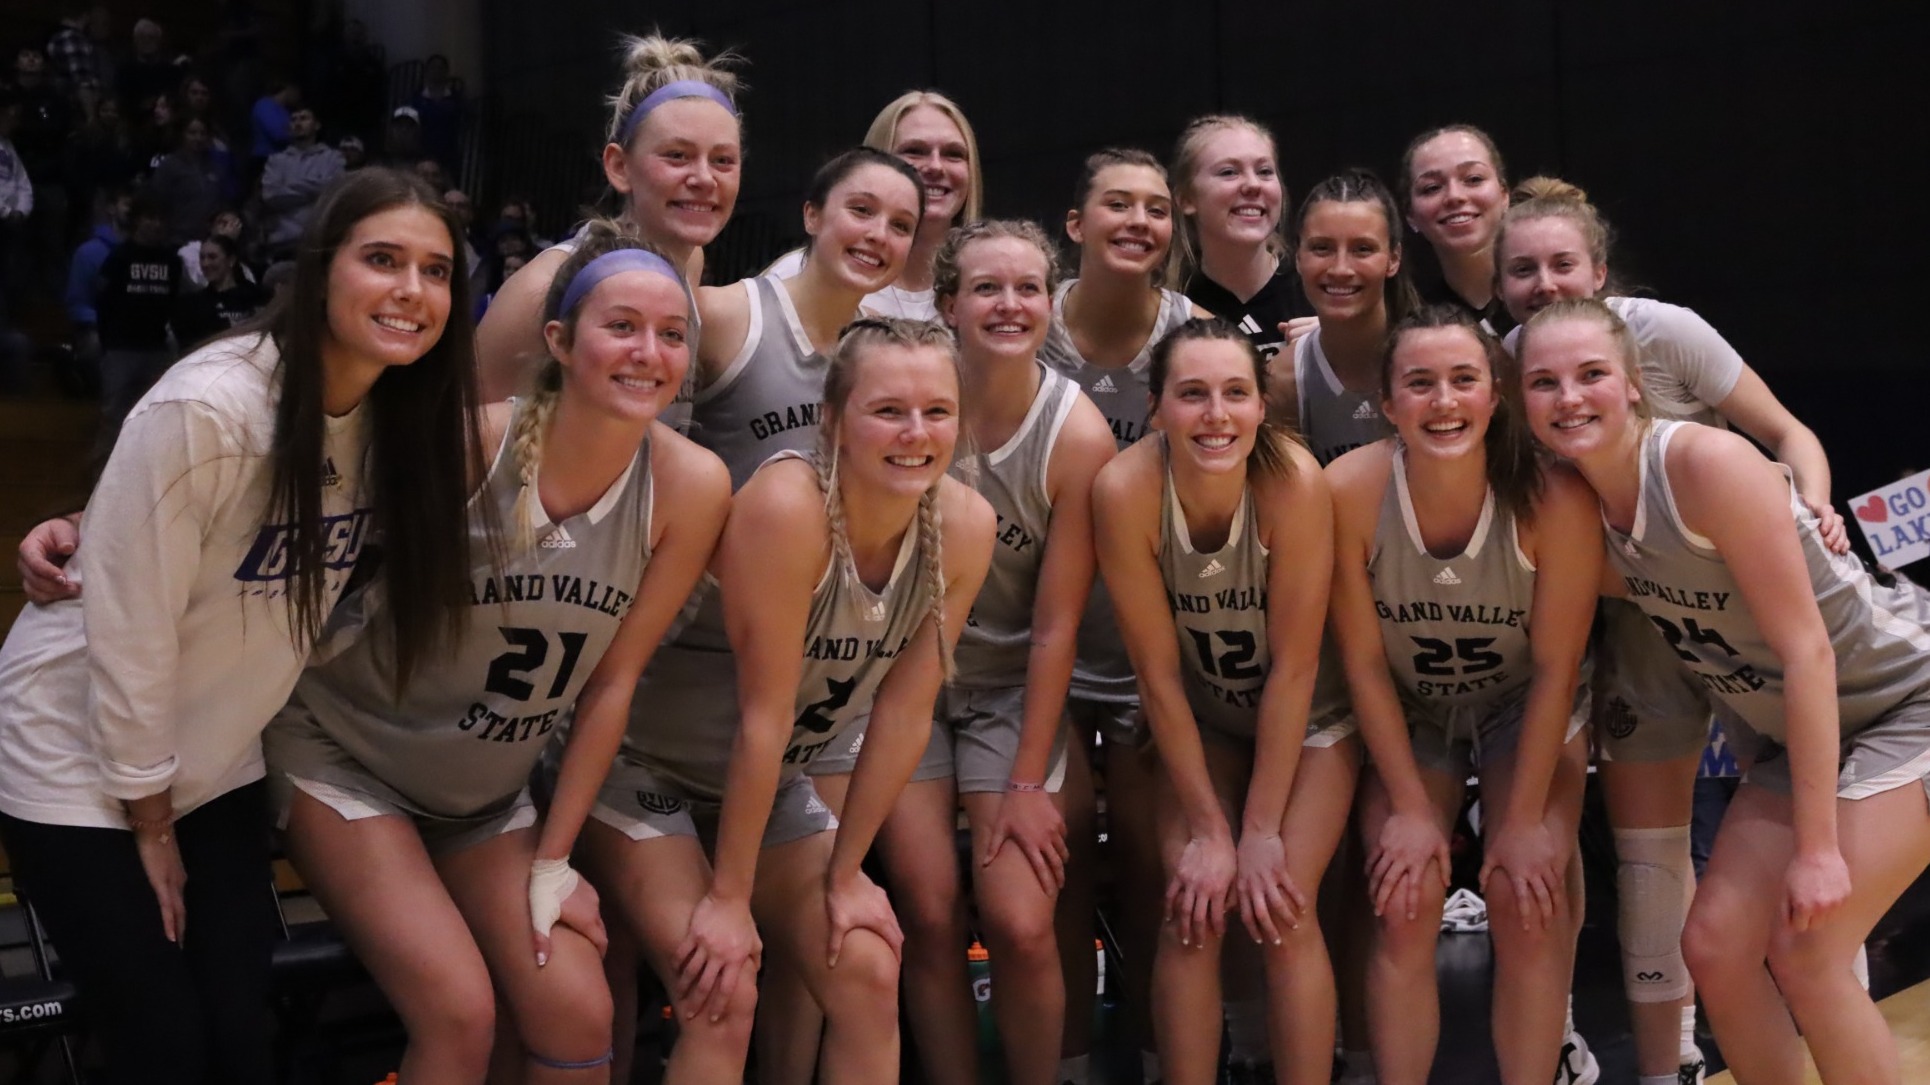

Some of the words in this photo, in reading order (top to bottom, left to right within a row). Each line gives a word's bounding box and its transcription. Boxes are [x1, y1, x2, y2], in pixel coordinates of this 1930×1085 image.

[130, 262, 168, 280] GVSU
[1888, 487, 1926, 516] GO
[257, 513, 372, 576] GSU
[541, 538, 576, 548] adidas
[1870, 513, 1930, 556] LAK
[552, 575, 634, 621] VALLE
[1447, 605, 1525, 627] VALLE
[485, 626, 588, 701] 21
[803, 635, 859, 661] AND
[1185, 626, 1263, 680] 12
[1409, 635, 1503, 676] 25
[1417, 671, 1509, 696] STATE
[458, 702, 558, 742] STATE
[0, 1001, 62, 1022] s.com
